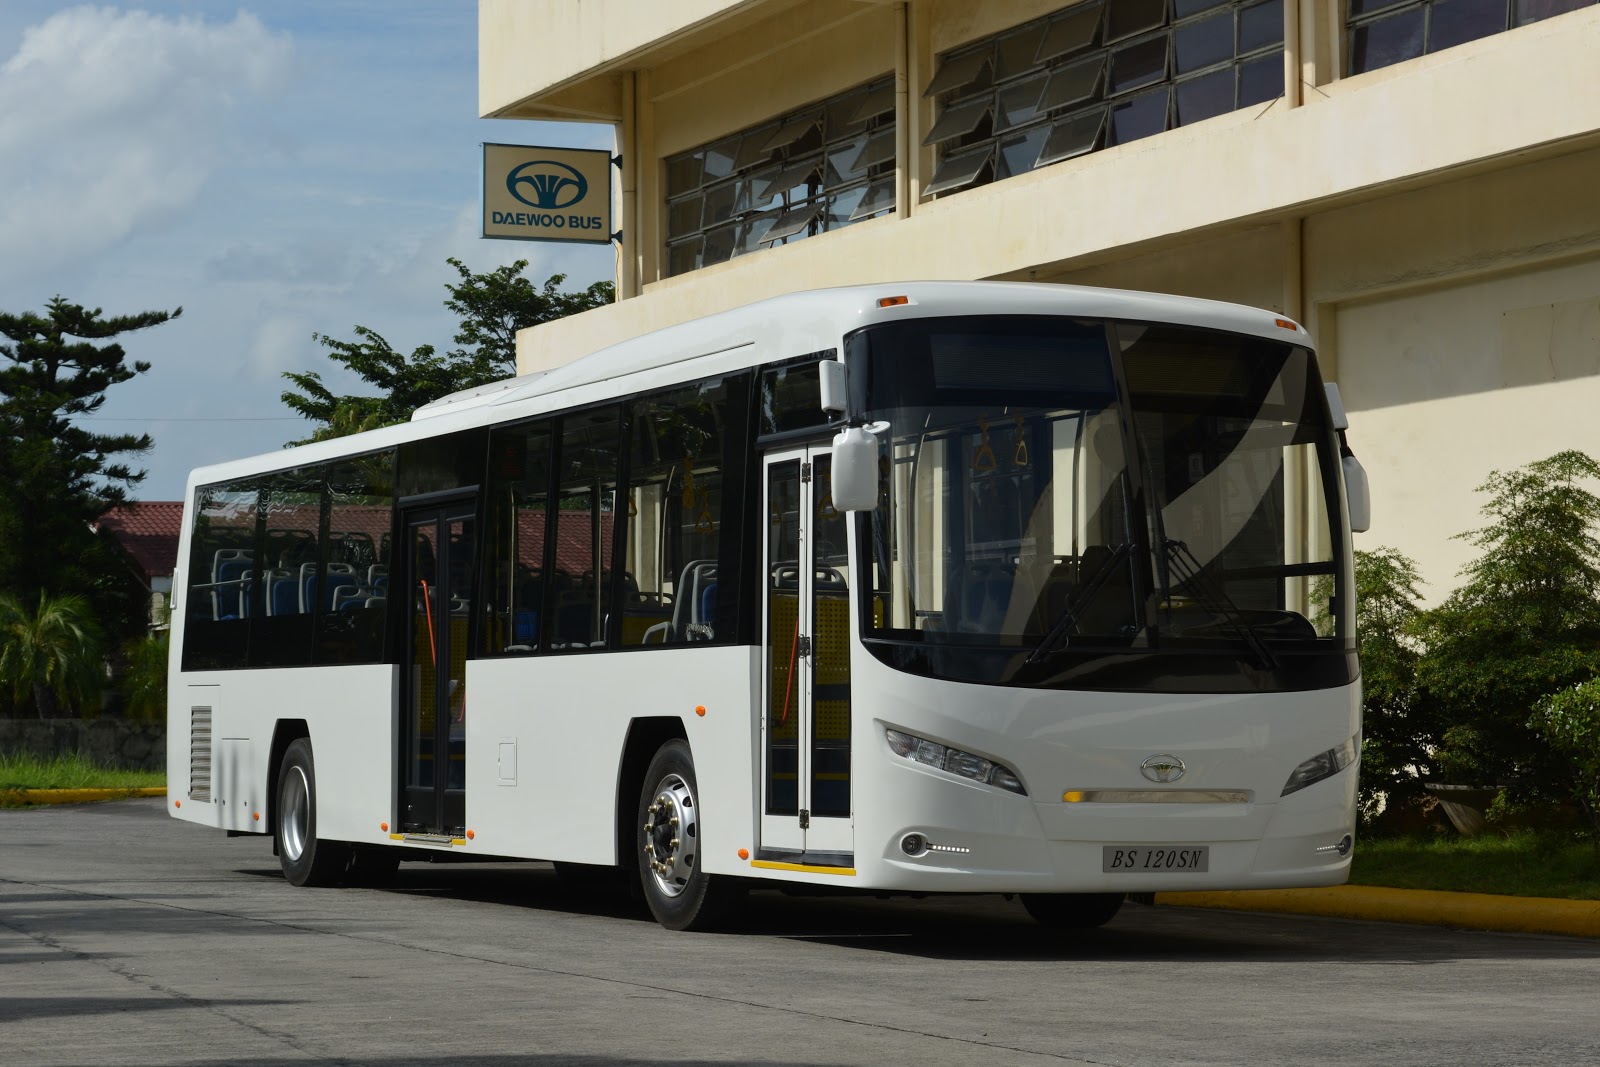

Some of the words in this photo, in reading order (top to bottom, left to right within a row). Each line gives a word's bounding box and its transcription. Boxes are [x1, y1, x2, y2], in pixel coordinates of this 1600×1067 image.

[492, 211, 565, 228] DAEWOO
[568, 215, 603, 230] BUS
[1110, 850, 1138, 868] BS
[1143, 850, 1203, 868] 120SN
